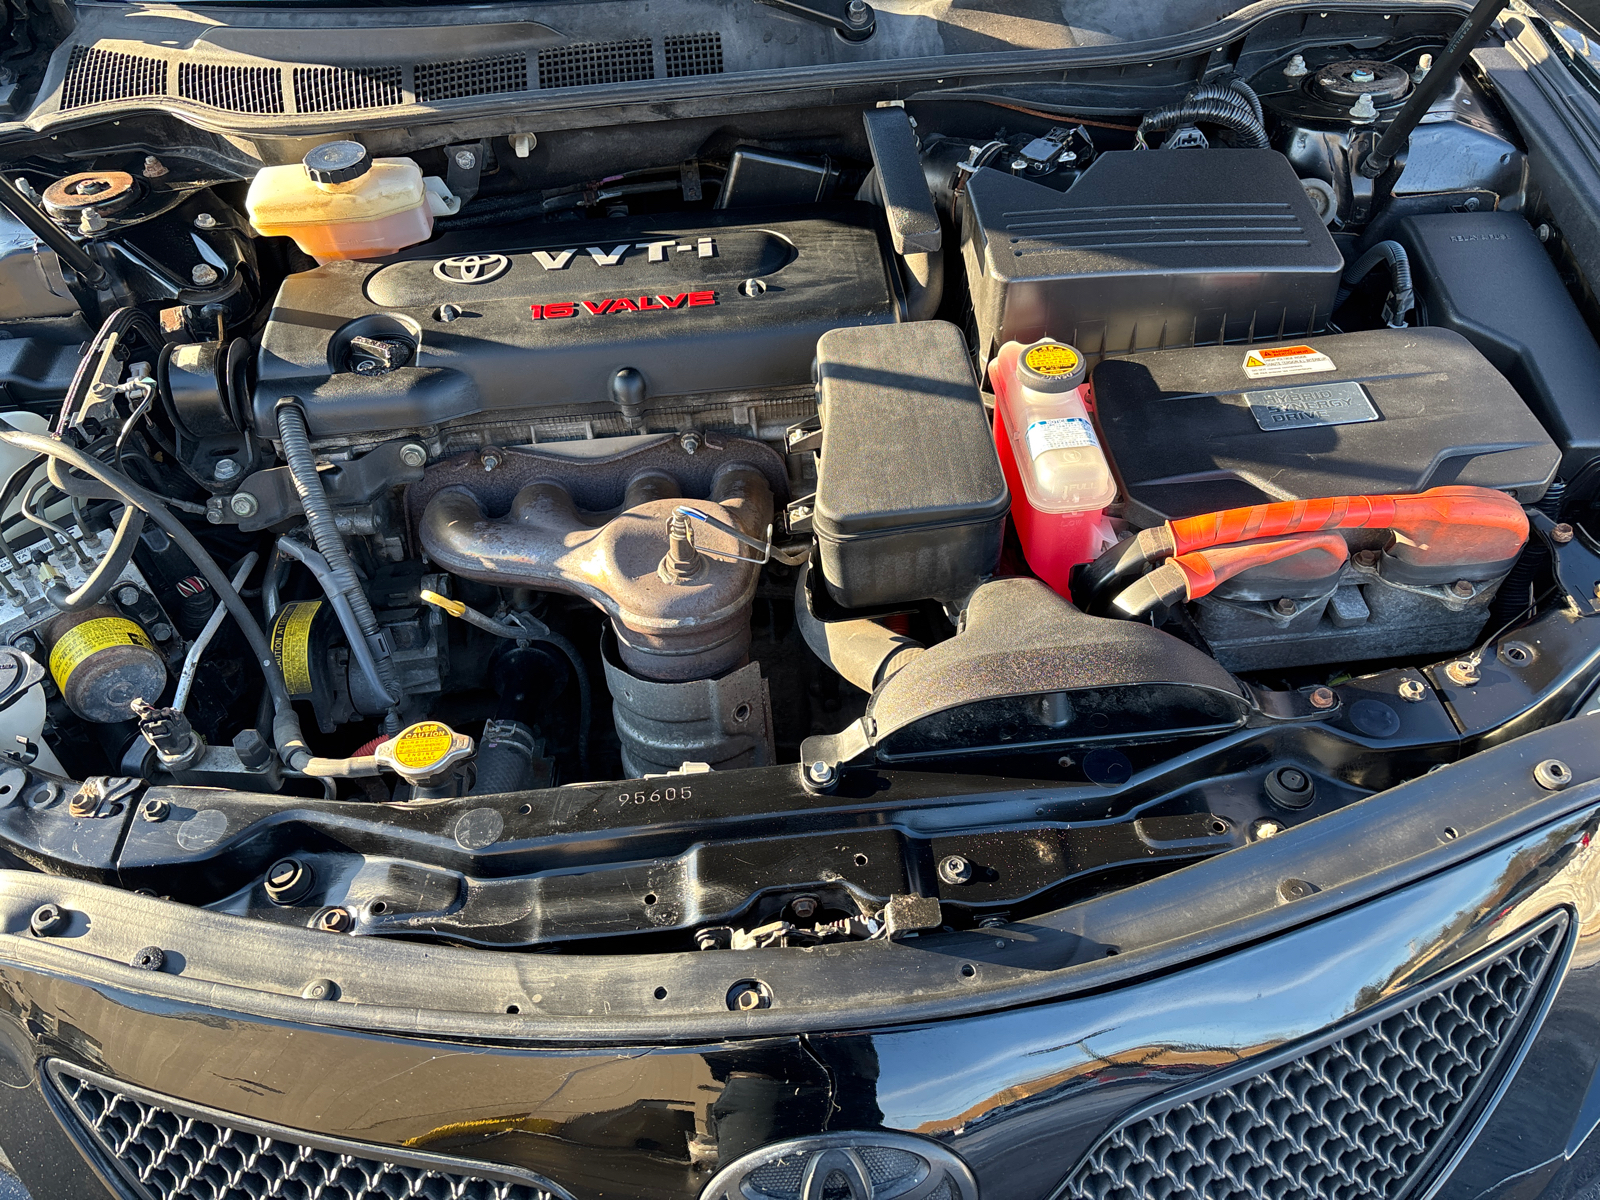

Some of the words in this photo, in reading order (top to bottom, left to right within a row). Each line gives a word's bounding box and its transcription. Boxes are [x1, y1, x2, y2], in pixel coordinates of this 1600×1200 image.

[1449, 234, 1479, 242] RELAY
[530, 301, 576, 321] 16
[581, 290, 716, 316] VALVE
[1263, 390, 1332, 404] HYBRID
[1267, 397, 1352, 414] SYNERGY
[1272, 410, 1331, 423] DRIVE
[1069, 482, 1098, 491] FULL
[1060, 519, 1083, 528] LOW
[405, 730, 445, 739] CAUTION
[618, 785, 693, 807] 95605
